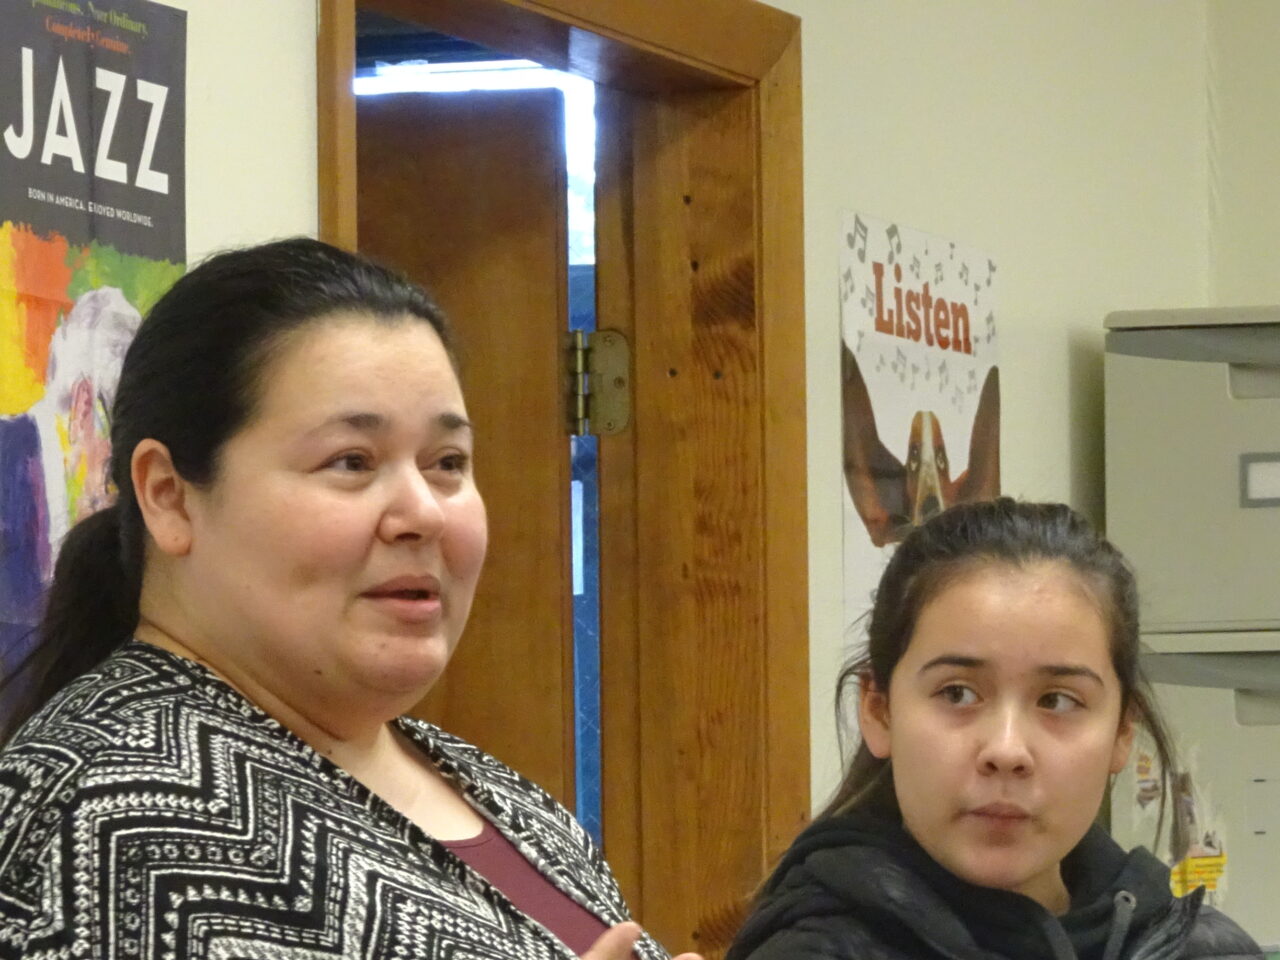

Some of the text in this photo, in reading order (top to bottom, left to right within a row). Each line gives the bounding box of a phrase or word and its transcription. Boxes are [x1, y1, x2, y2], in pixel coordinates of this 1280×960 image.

[3, 46, 169, 195] JAZZ
[28, 187, 46, 201] BORN
[47, 192, 54, 203] IN
[55, 194, 86, 211] AMERICA.
[116, 208, 154, 227] WORLDWIDE.
[872, 262, 972, 355] Listen
